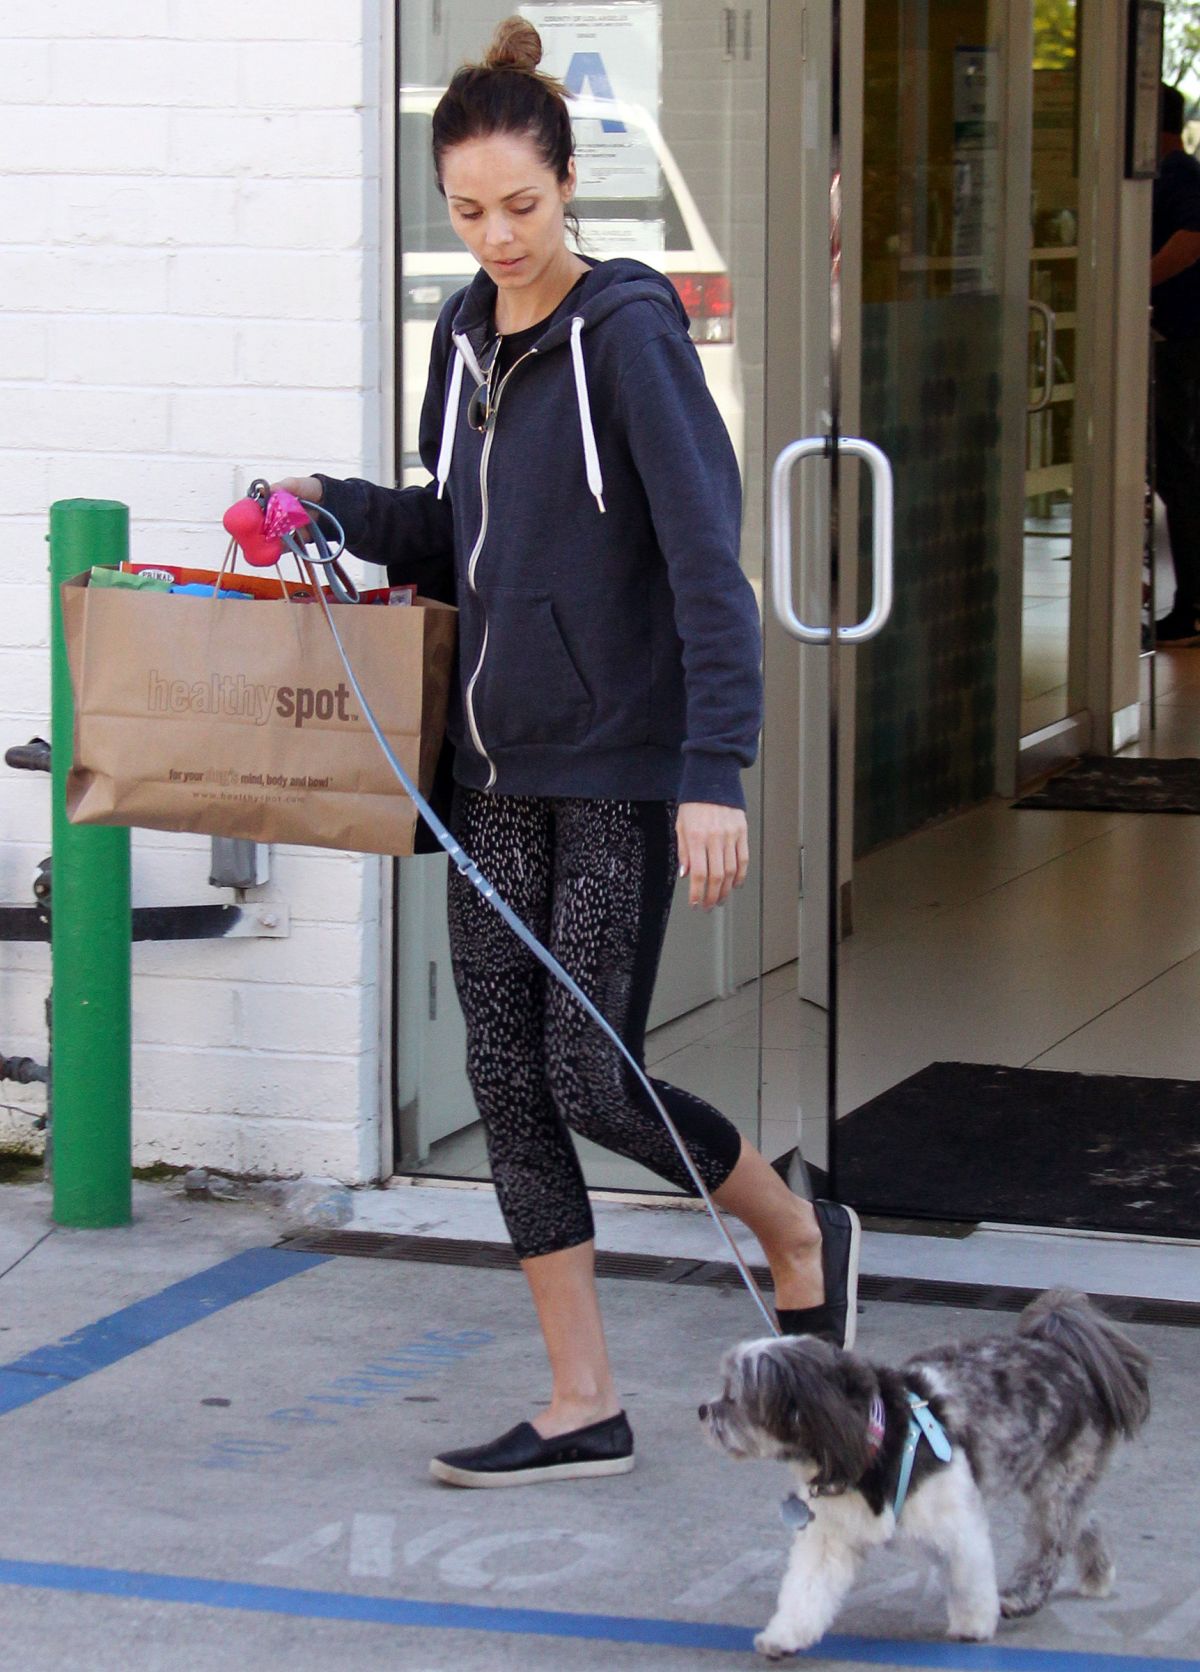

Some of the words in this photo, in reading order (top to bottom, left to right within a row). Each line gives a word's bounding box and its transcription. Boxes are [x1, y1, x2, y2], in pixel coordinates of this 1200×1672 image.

[562, 52, 627, 133] A
[169, 768, 182, 780] for
[183, 771, 204, 783] your
[240, 773, 265, 787] mind,
[266, 774, 288, 788] body
[289, 776, 306, 787] and
